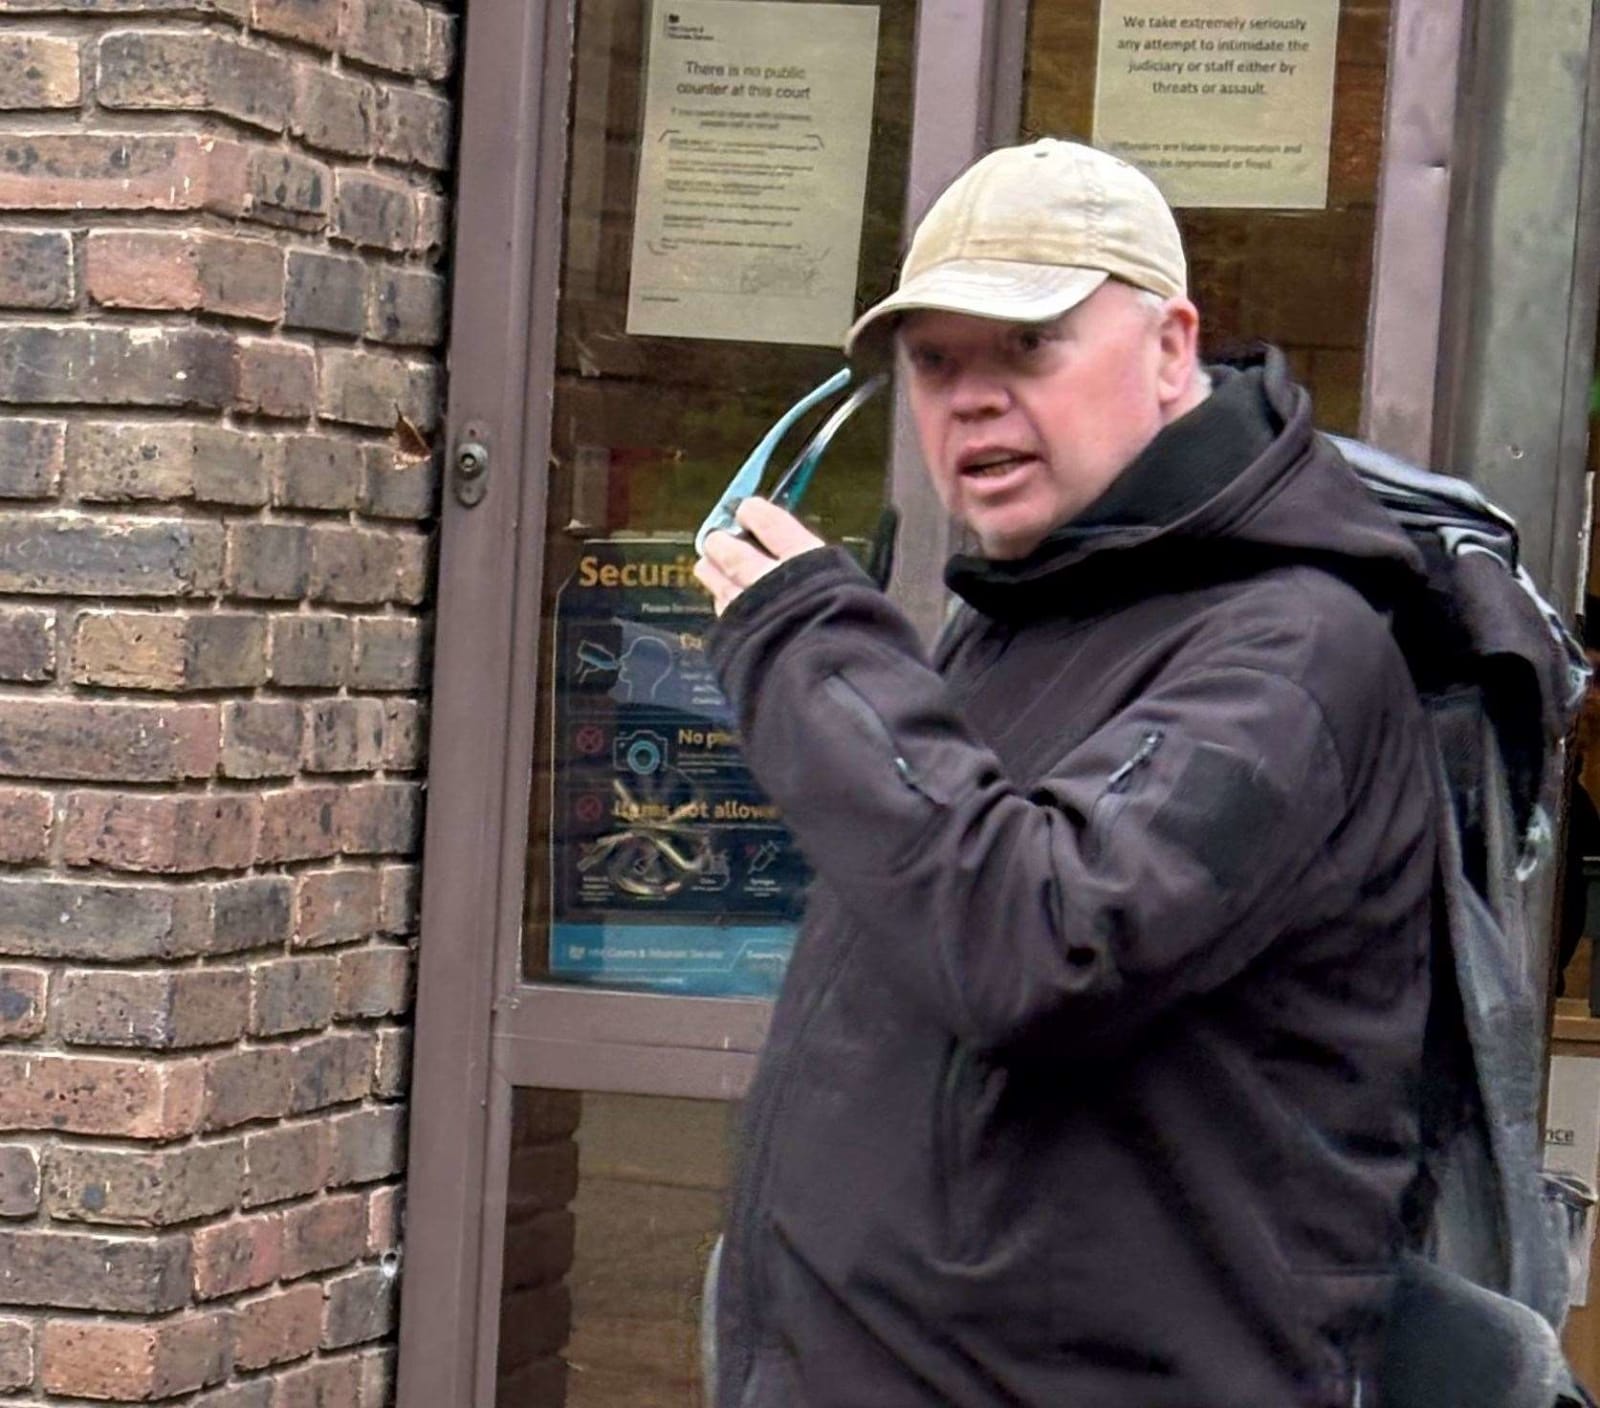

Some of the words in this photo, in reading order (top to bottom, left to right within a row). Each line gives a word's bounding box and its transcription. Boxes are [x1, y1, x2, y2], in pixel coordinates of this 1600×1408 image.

[1123, 16, 1145, 28] We
[1149, 16, 1177, 29] take
[1180, 17, 1246, 31] extremely
[1250, 18, 1306, 32] seriously
[1118, 40, 1140, 52] any
[1144, 39, 1197, 53] attempt
[1200, 40, 1214, 51] to
[1218, 39, 1284, 51] intimidate
[1288, 40, 1309, 51] the
[686, 61, 725, 76] There
[728, 63, 740, 77] is
[744, 66, 761, 77] no
[764, 64, 806, 80] public
[1128, 60, 1184, 74] judiciary
[1187, 62, 1202, 73] or
[1205, 60, 1235, 73] staff
[1238, 61, 1275, 73] either
[1279, 61, 1297, 75] by
[677, 82, 729, 96] counter
[731, 83, 747, 96] at
[748, 84, 772, 97] this
[775, 87, 811, 99] court
[1152, 81, 1198, 94] threats
[1202, 84, 1216, 94] or
